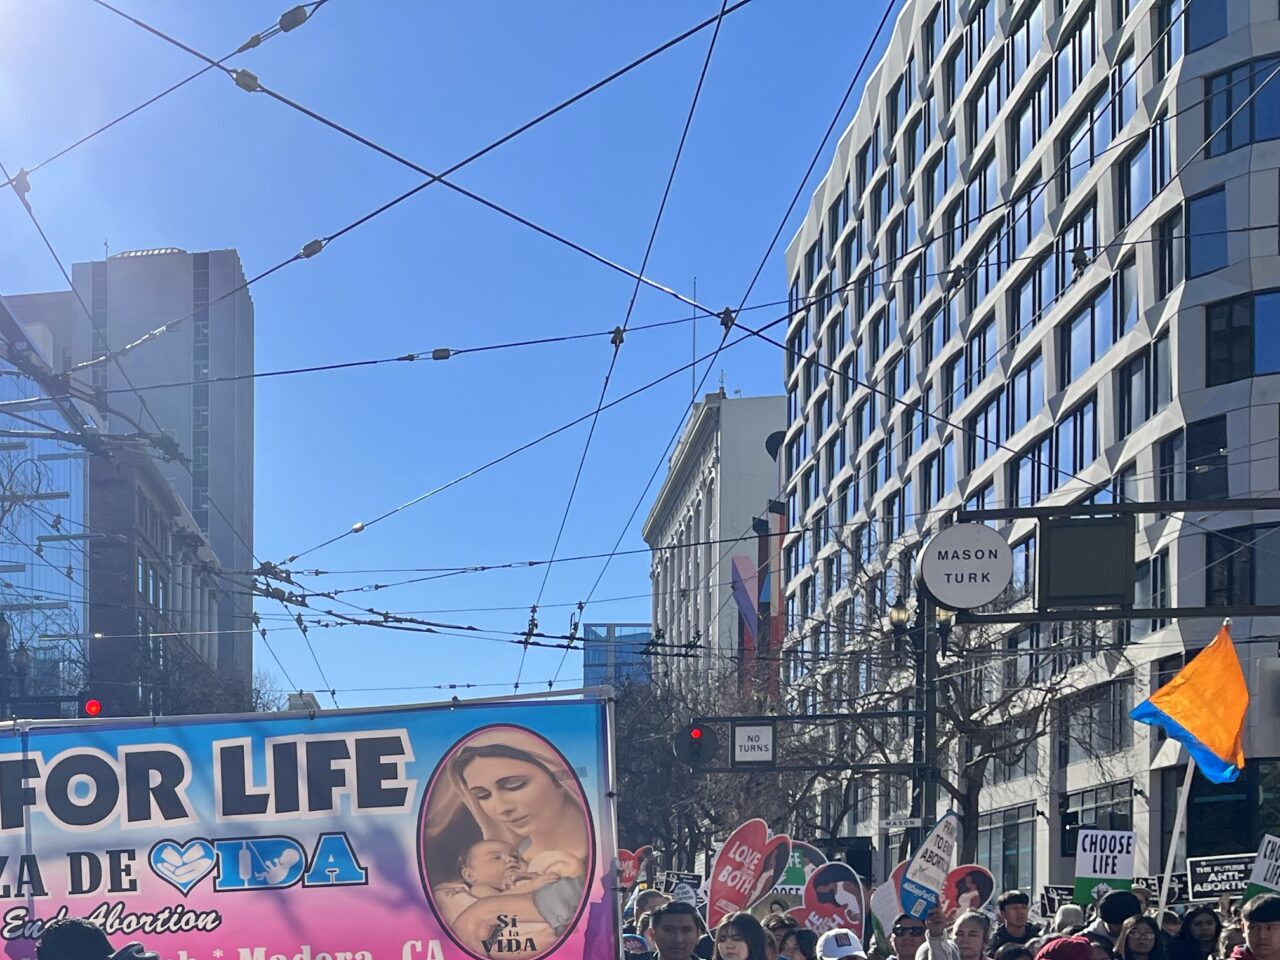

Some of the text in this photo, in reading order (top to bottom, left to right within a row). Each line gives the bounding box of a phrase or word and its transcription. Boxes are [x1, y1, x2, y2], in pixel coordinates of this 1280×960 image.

[937, 549, 999, 561] MASON
[945, 572, 992, 584] TURK
[747, 735, 760, 743] NO
[739, 745, 770, 753] TURNS
[216, 732, 412, 819] LIFE
[1081, 834, 1133, 855] CHOOSE
[728, 841, 762, 870] LOVE
[66, 849, 138, 895] DE
[1092, 855, 1118, 875] LIFE
[1214, 864, 1245, 872] FUTURE
[718, 865, 754, 895] BOTH
[1208, 871, 1245, 882] ANTI-
[1194, 881, 1249, 892] ABORTIO
[89, 902, 222, 937] Abortion
[496, 914, 518, 928] Sí
[481, 938, 538, 953] VIDA
